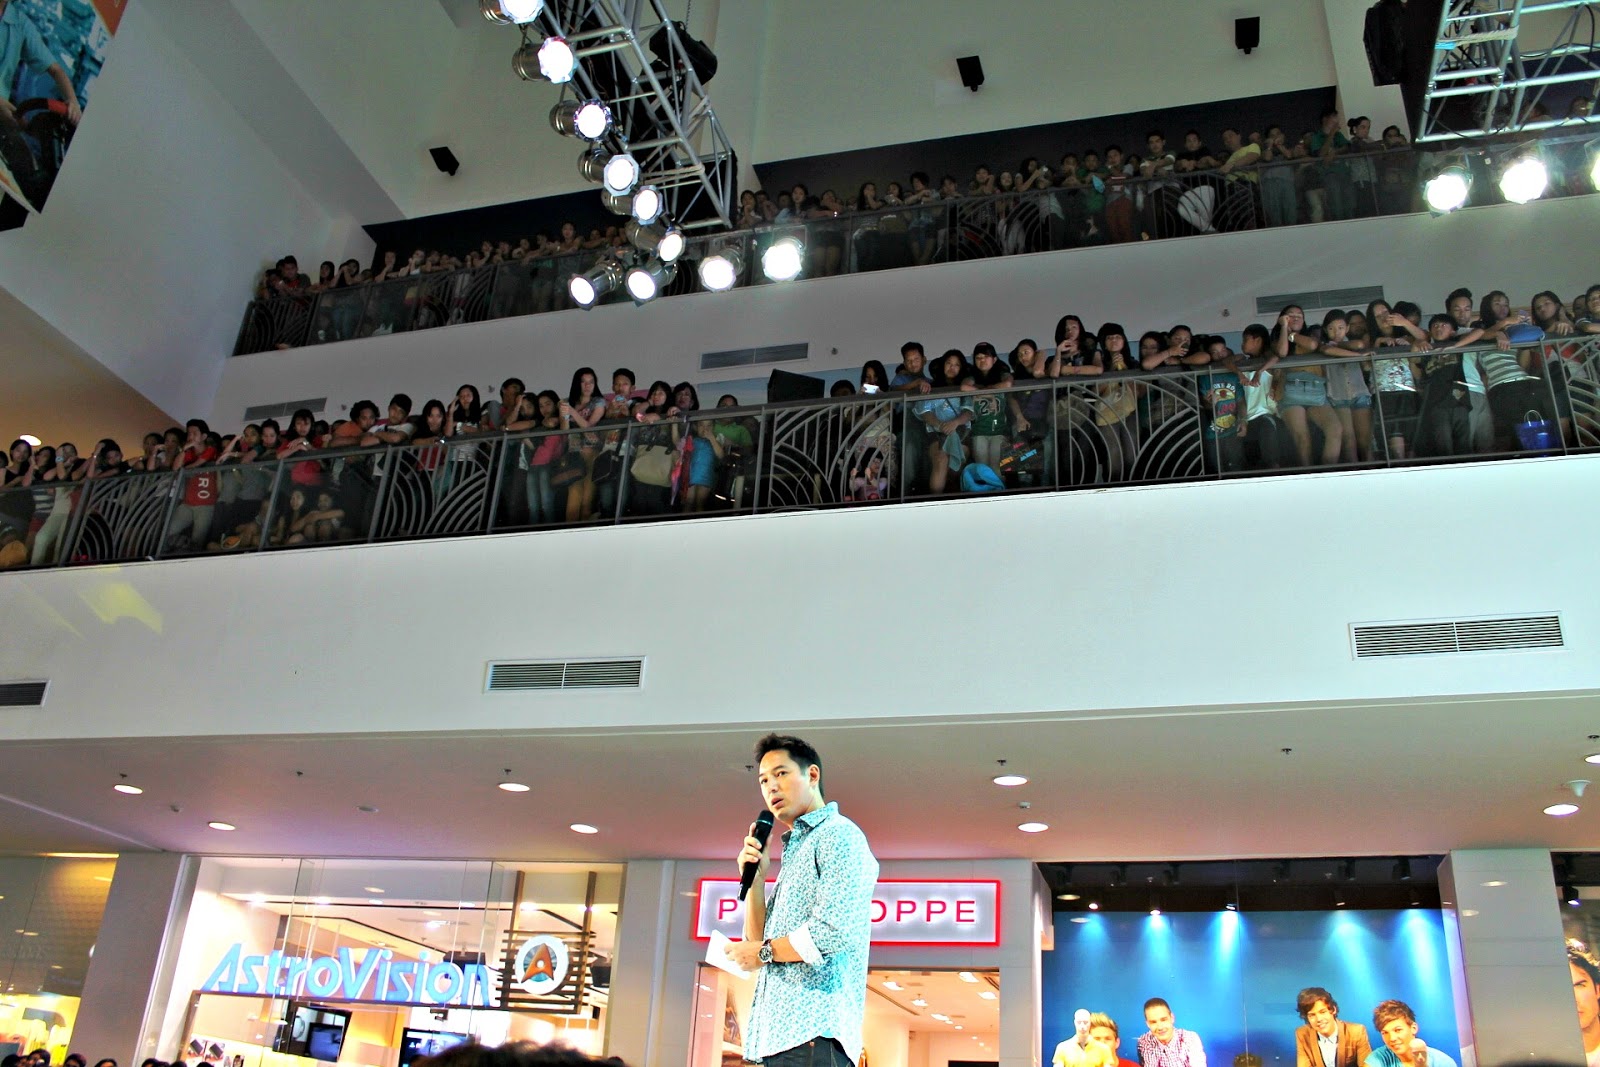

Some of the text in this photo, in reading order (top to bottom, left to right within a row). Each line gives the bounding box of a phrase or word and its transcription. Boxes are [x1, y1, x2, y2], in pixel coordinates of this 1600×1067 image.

[197, 474, 210, 499] RO
[717, 897, 976, 923] POPPE
[201, 942, 491, 1007] AstroVision
